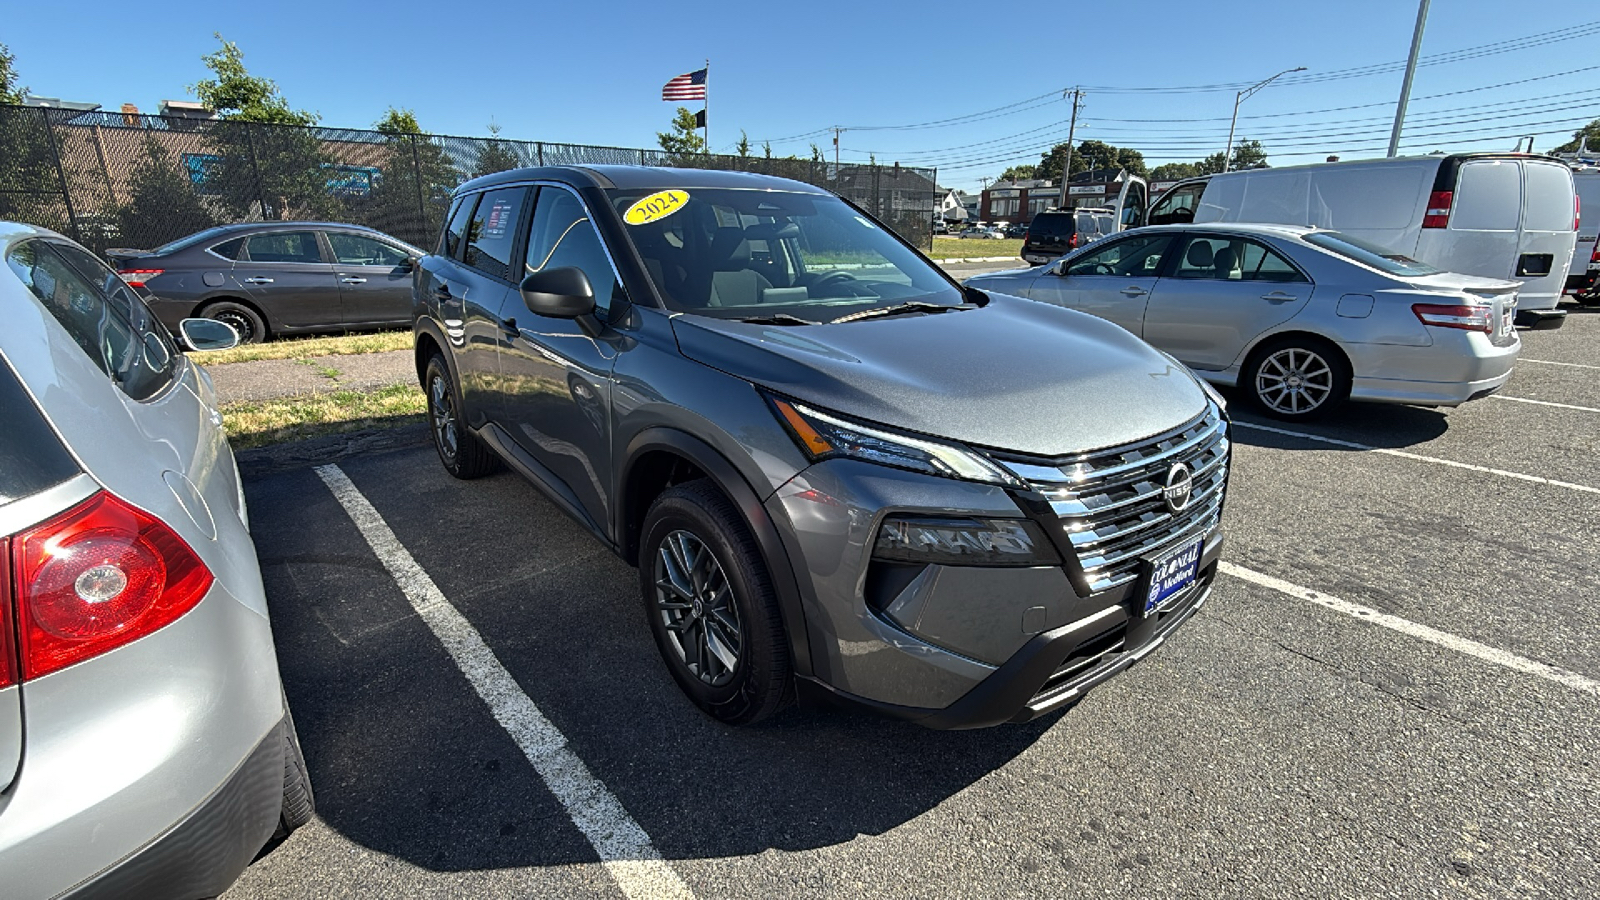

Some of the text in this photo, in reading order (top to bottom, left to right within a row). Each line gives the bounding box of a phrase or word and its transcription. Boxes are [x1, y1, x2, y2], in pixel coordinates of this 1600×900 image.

[636, 192, 679, 221] 2024
[1150, 542, 1198, 585] COLONIAL
[1161, 564, 1194, 592] Medford
